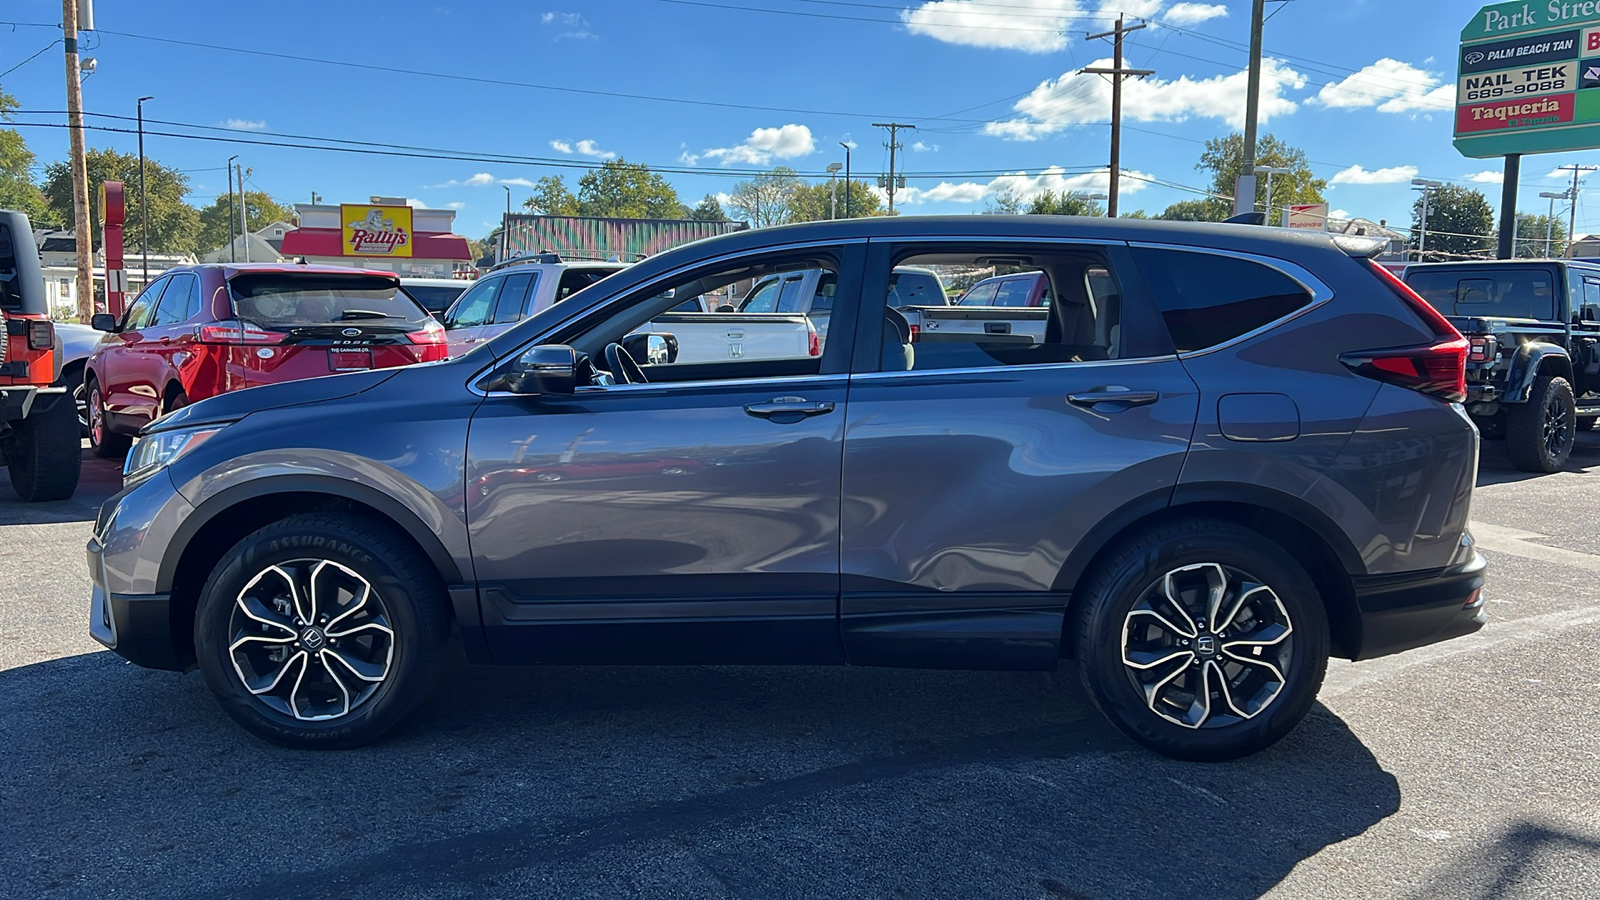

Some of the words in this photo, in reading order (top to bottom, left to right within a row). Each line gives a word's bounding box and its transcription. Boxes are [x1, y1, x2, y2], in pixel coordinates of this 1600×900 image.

[1484, 4, 1536, 32] Park
[1487, 48, 1515, 61] PALM
[1516, 43, 1550, 57] BEACH
[1552, 39, 1574, 51] TAN
[1466, 74, 1513, 90] NAIL
[1522, 65, 1568, 82] TEK
[1467, 79, 1566, 101] 689-9088
[350, 227, 407, 252] Rally's
[270, 535, 373, 563] ASSURANCE
